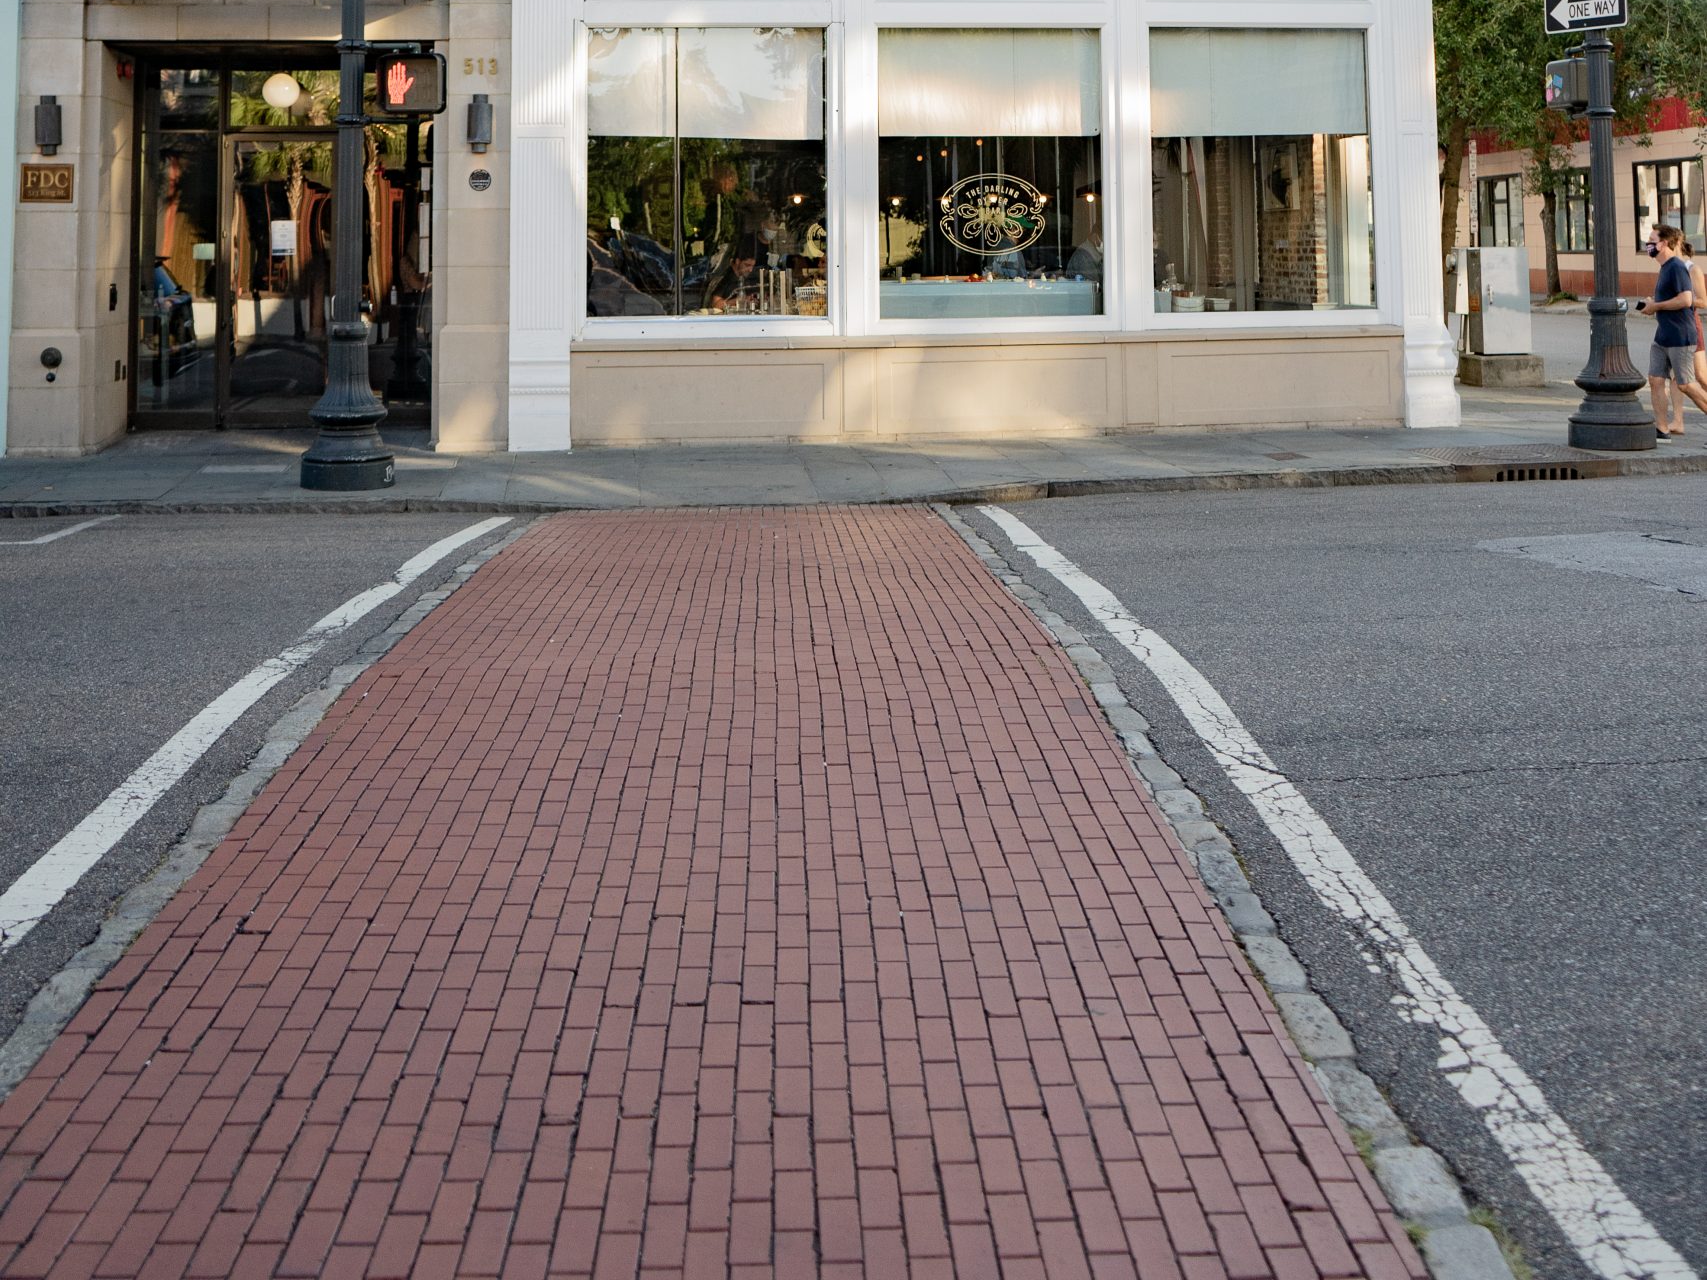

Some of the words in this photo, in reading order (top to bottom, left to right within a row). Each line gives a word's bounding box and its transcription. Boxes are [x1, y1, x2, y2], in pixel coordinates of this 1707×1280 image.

[1568, 2, 1591, 19] ONE
[1594, 0, 1617, 16] WAY
[463, 57, 497, 75] 513
[26, 170, 69, 188] FDC
[965, 187, 981, 199] THE
[984, 185, 1020, 199] DARLING
[977, 196, 1009, 206] OYER
